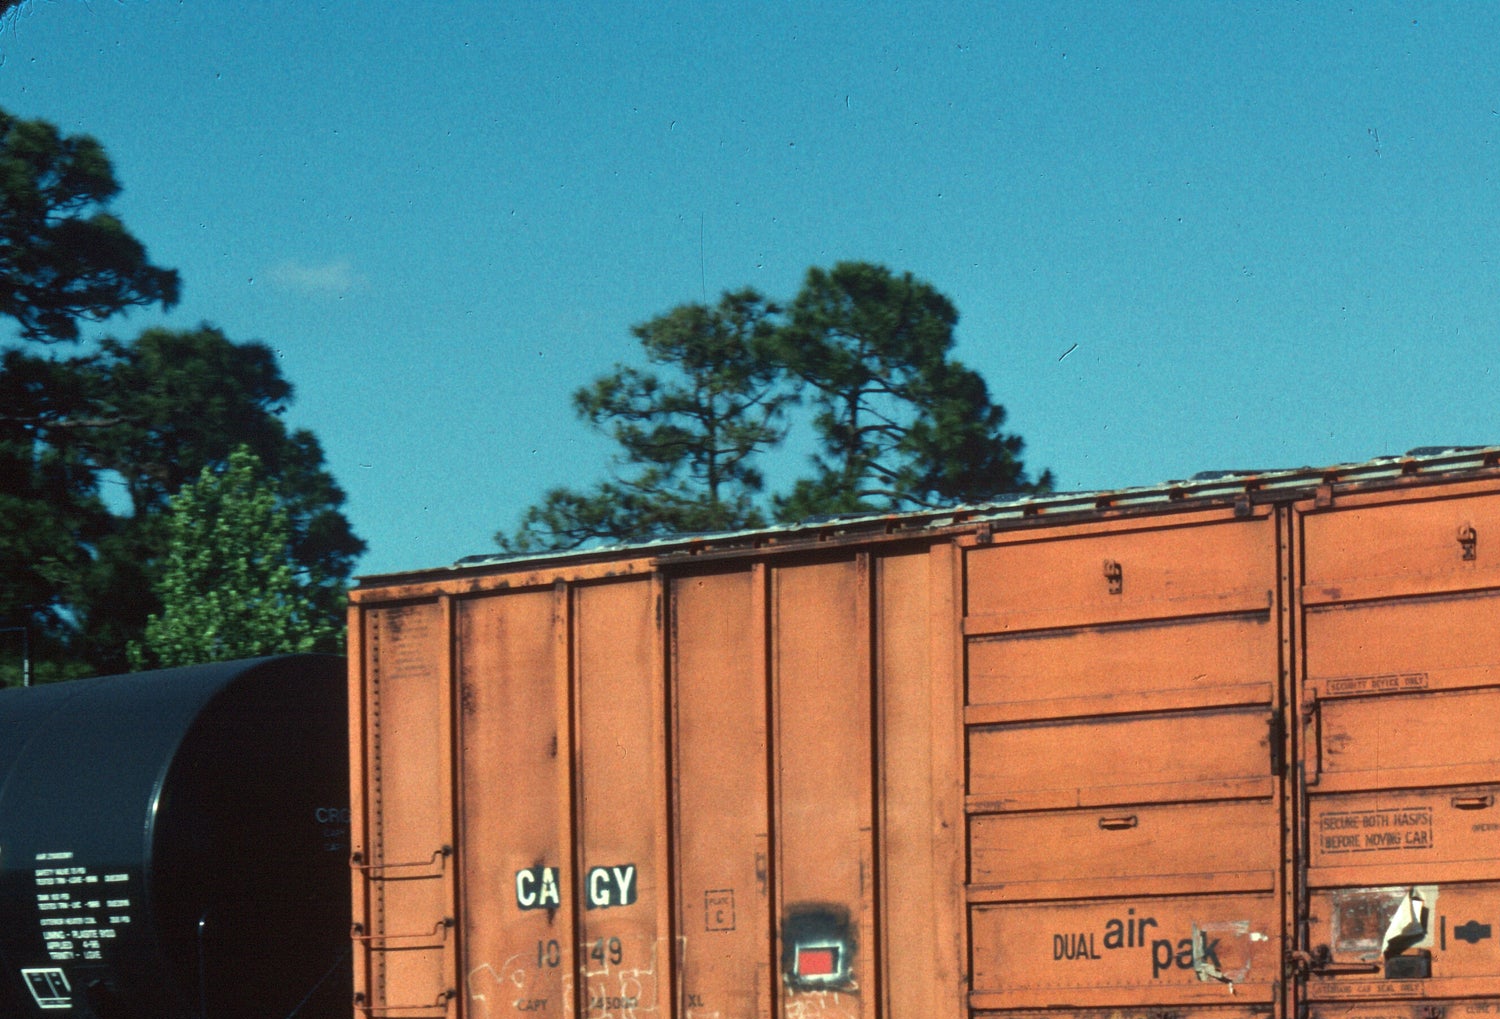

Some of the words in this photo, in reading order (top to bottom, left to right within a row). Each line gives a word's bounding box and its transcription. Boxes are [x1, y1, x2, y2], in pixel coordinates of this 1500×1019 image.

[1323, 816, 1360, 830] SECURE
[1362, 814, 1390, 828] BOTH
[1393, 812, 1428, 826] HASPS
[1325, 834, 1360, 849] BEFORE
[1365, 832, 1401, 847] MOVING
[1405, 830, 1428, 845] CAR
[716, 910, 724, 924] C
[1053, 933, 1102, 960] DUAL
